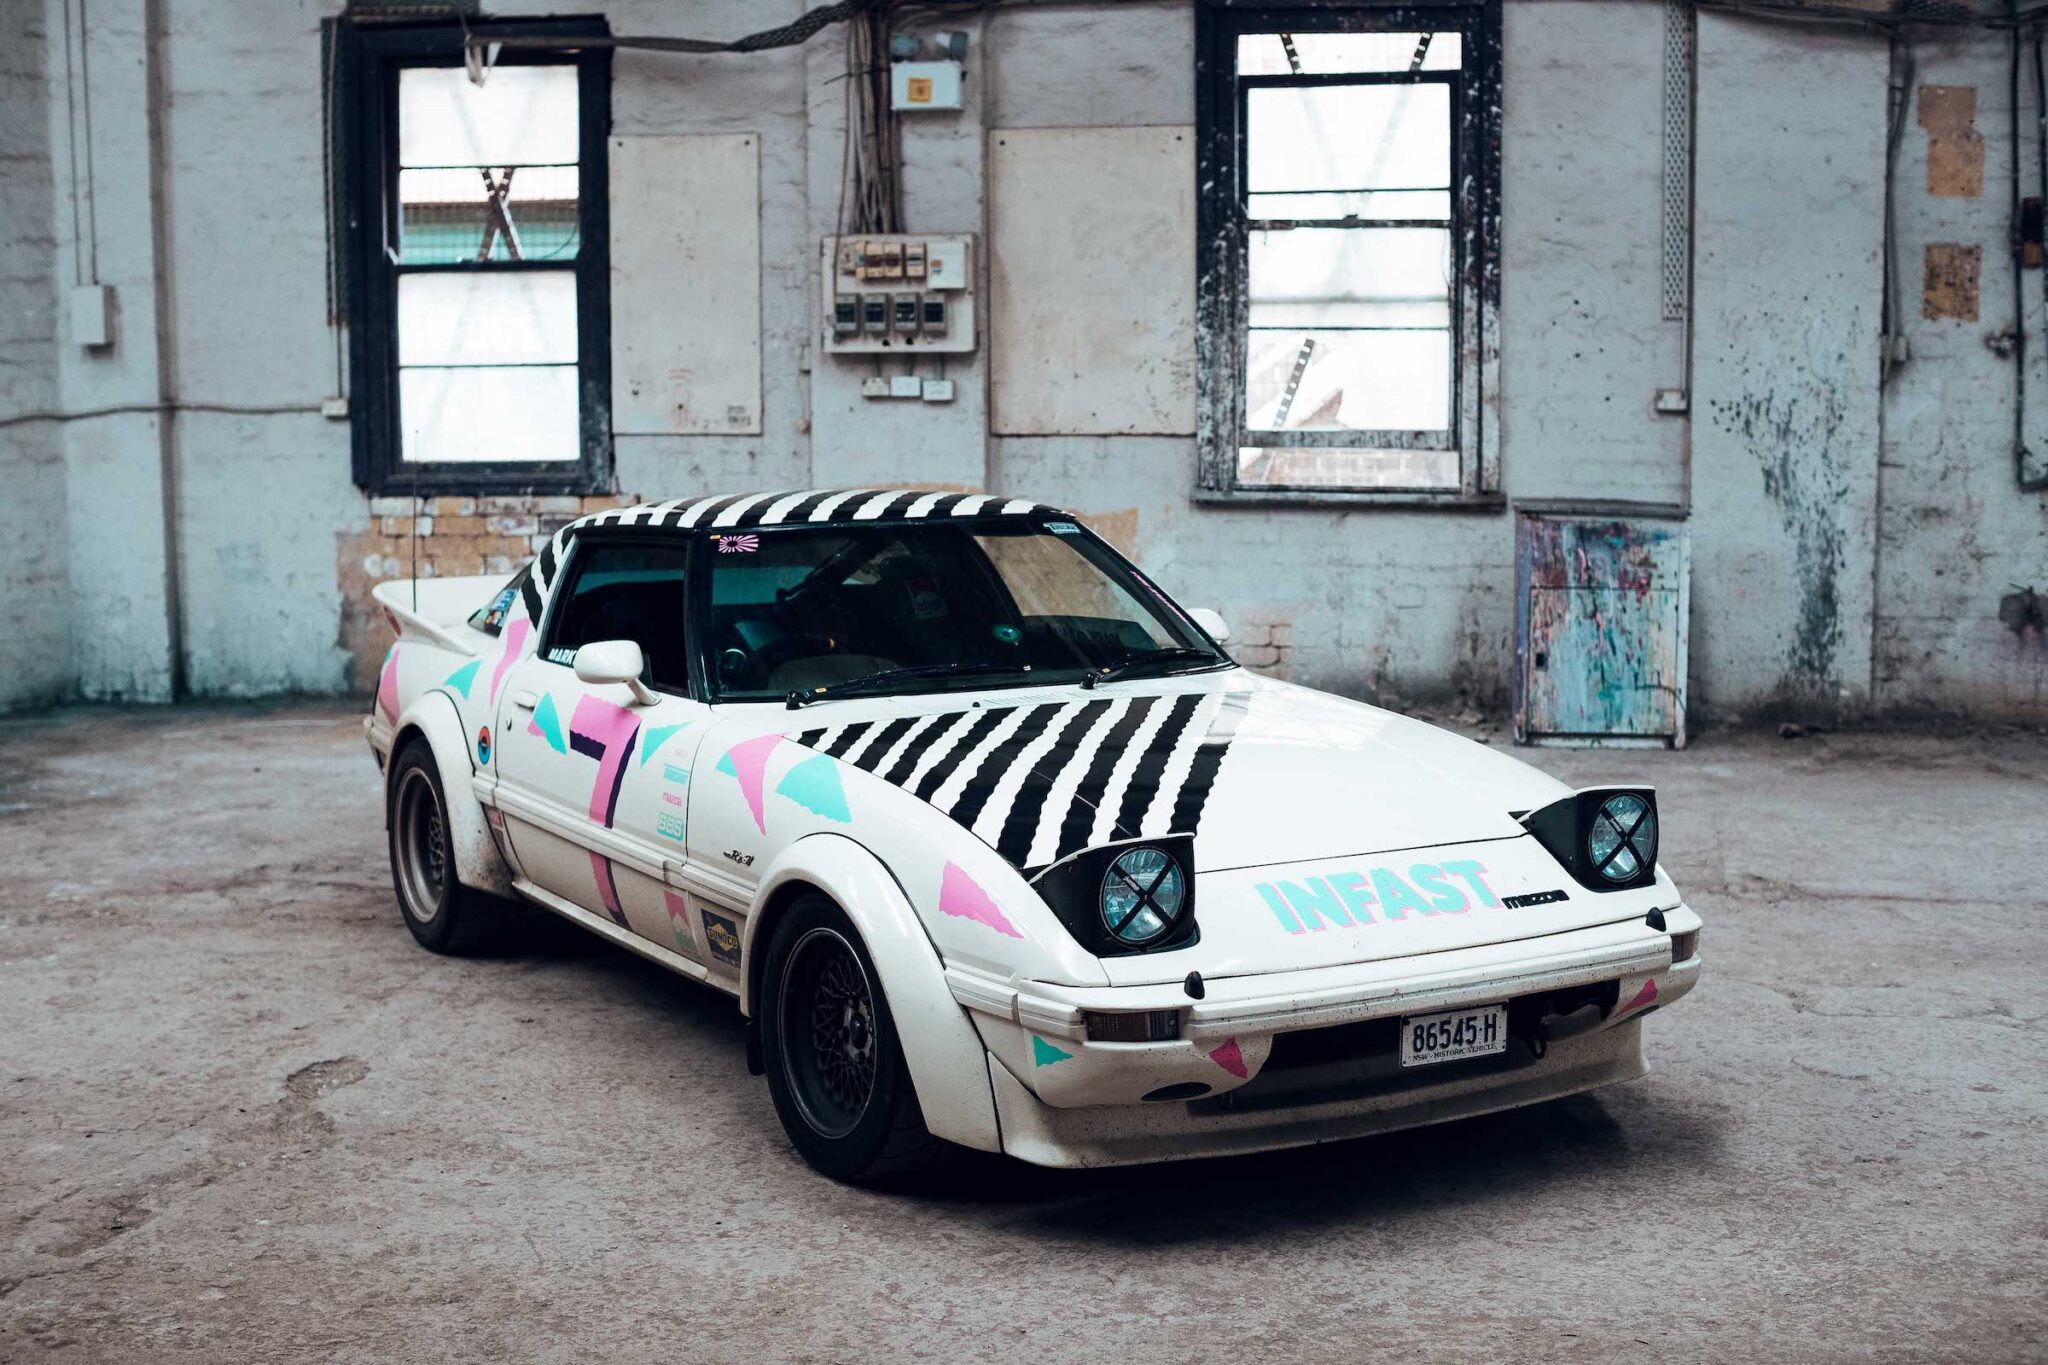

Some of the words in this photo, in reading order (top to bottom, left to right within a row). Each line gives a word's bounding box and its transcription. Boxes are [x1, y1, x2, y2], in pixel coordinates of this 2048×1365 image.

[657, 812, 685, 841] BBS
[1254, 860, 1504, 935] INFAST
[1501, 889, 1570, 909] mazda
